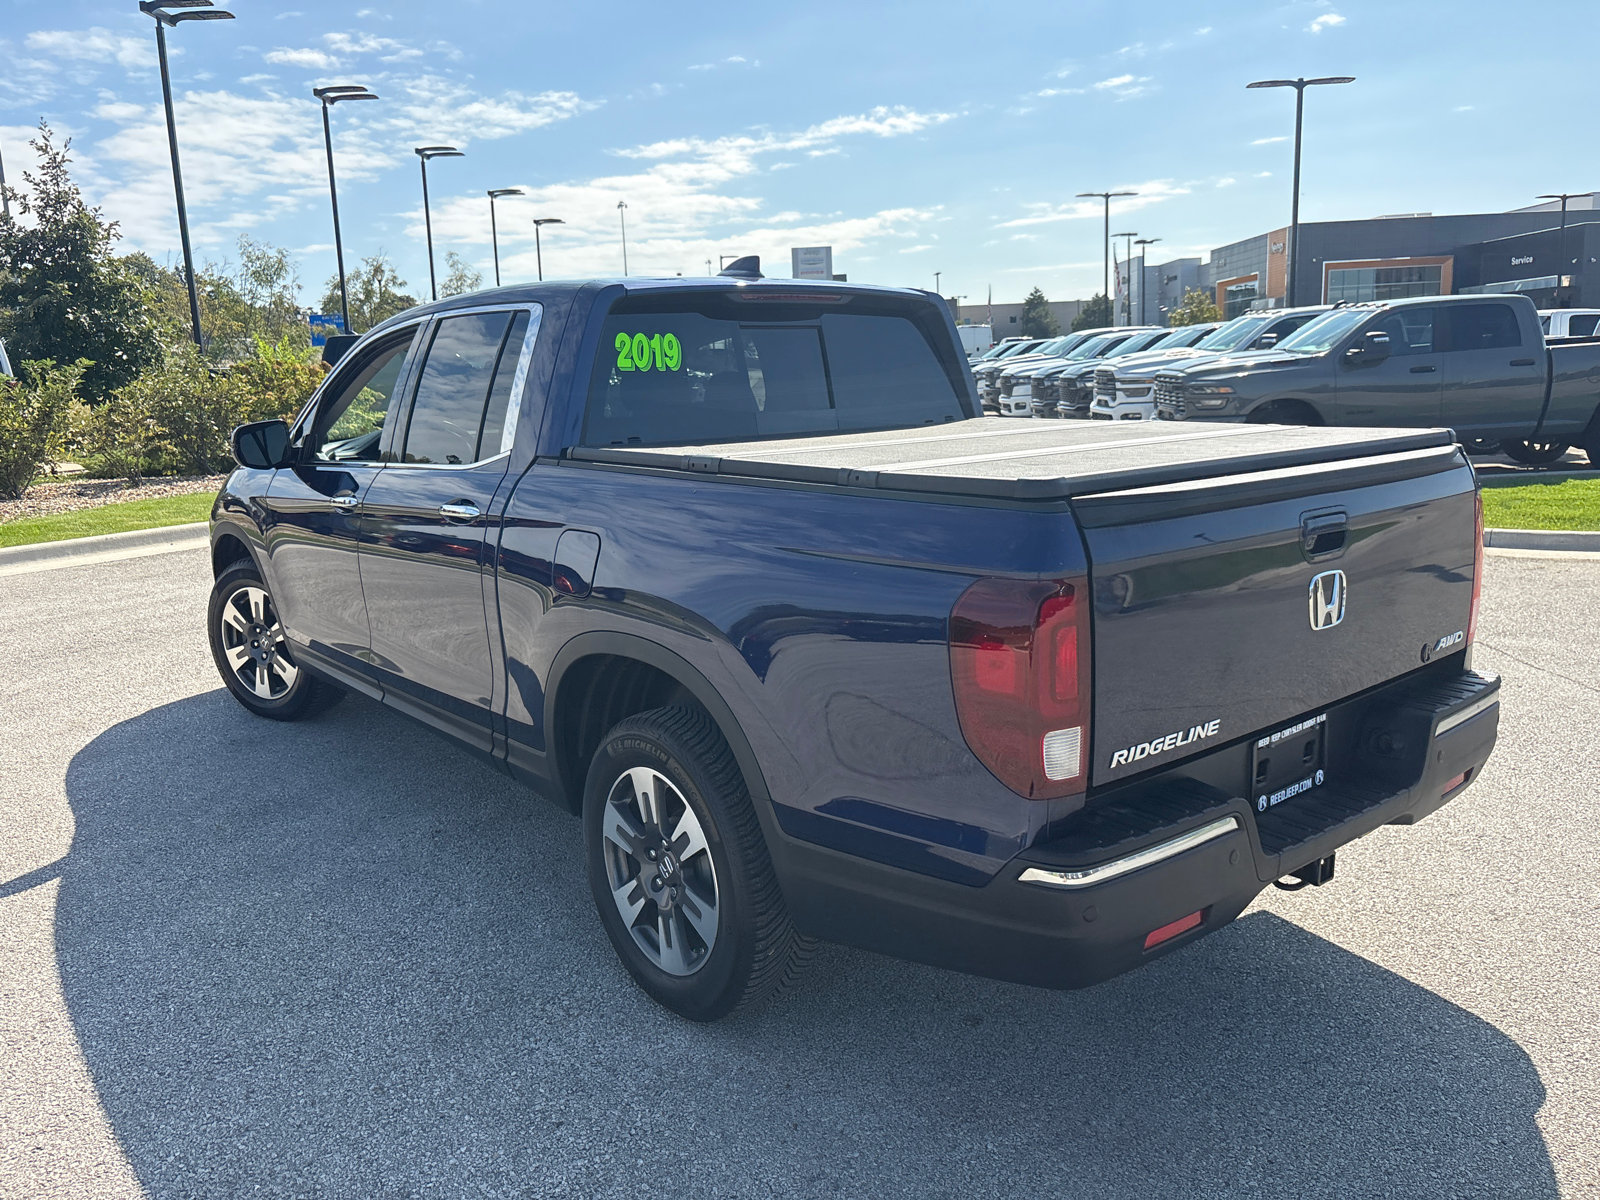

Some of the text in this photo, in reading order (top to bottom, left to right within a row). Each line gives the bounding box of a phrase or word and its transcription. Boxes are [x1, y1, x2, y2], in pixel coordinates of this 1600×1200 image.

[1511, 255, 1534, 266] Service
[614, 332, 682, 372] 2019
[1434, 630, 1463, 651] AWD
[1108, 718, 1221, 769] RIDGELINE
[1257, 713, 1327, 748] REED JEEP CHRYSLER DODGE RAM
[624, 739, 668, 762] MICHELIN
[1270, 778, 1312, 806] REEDJEEP.COM
